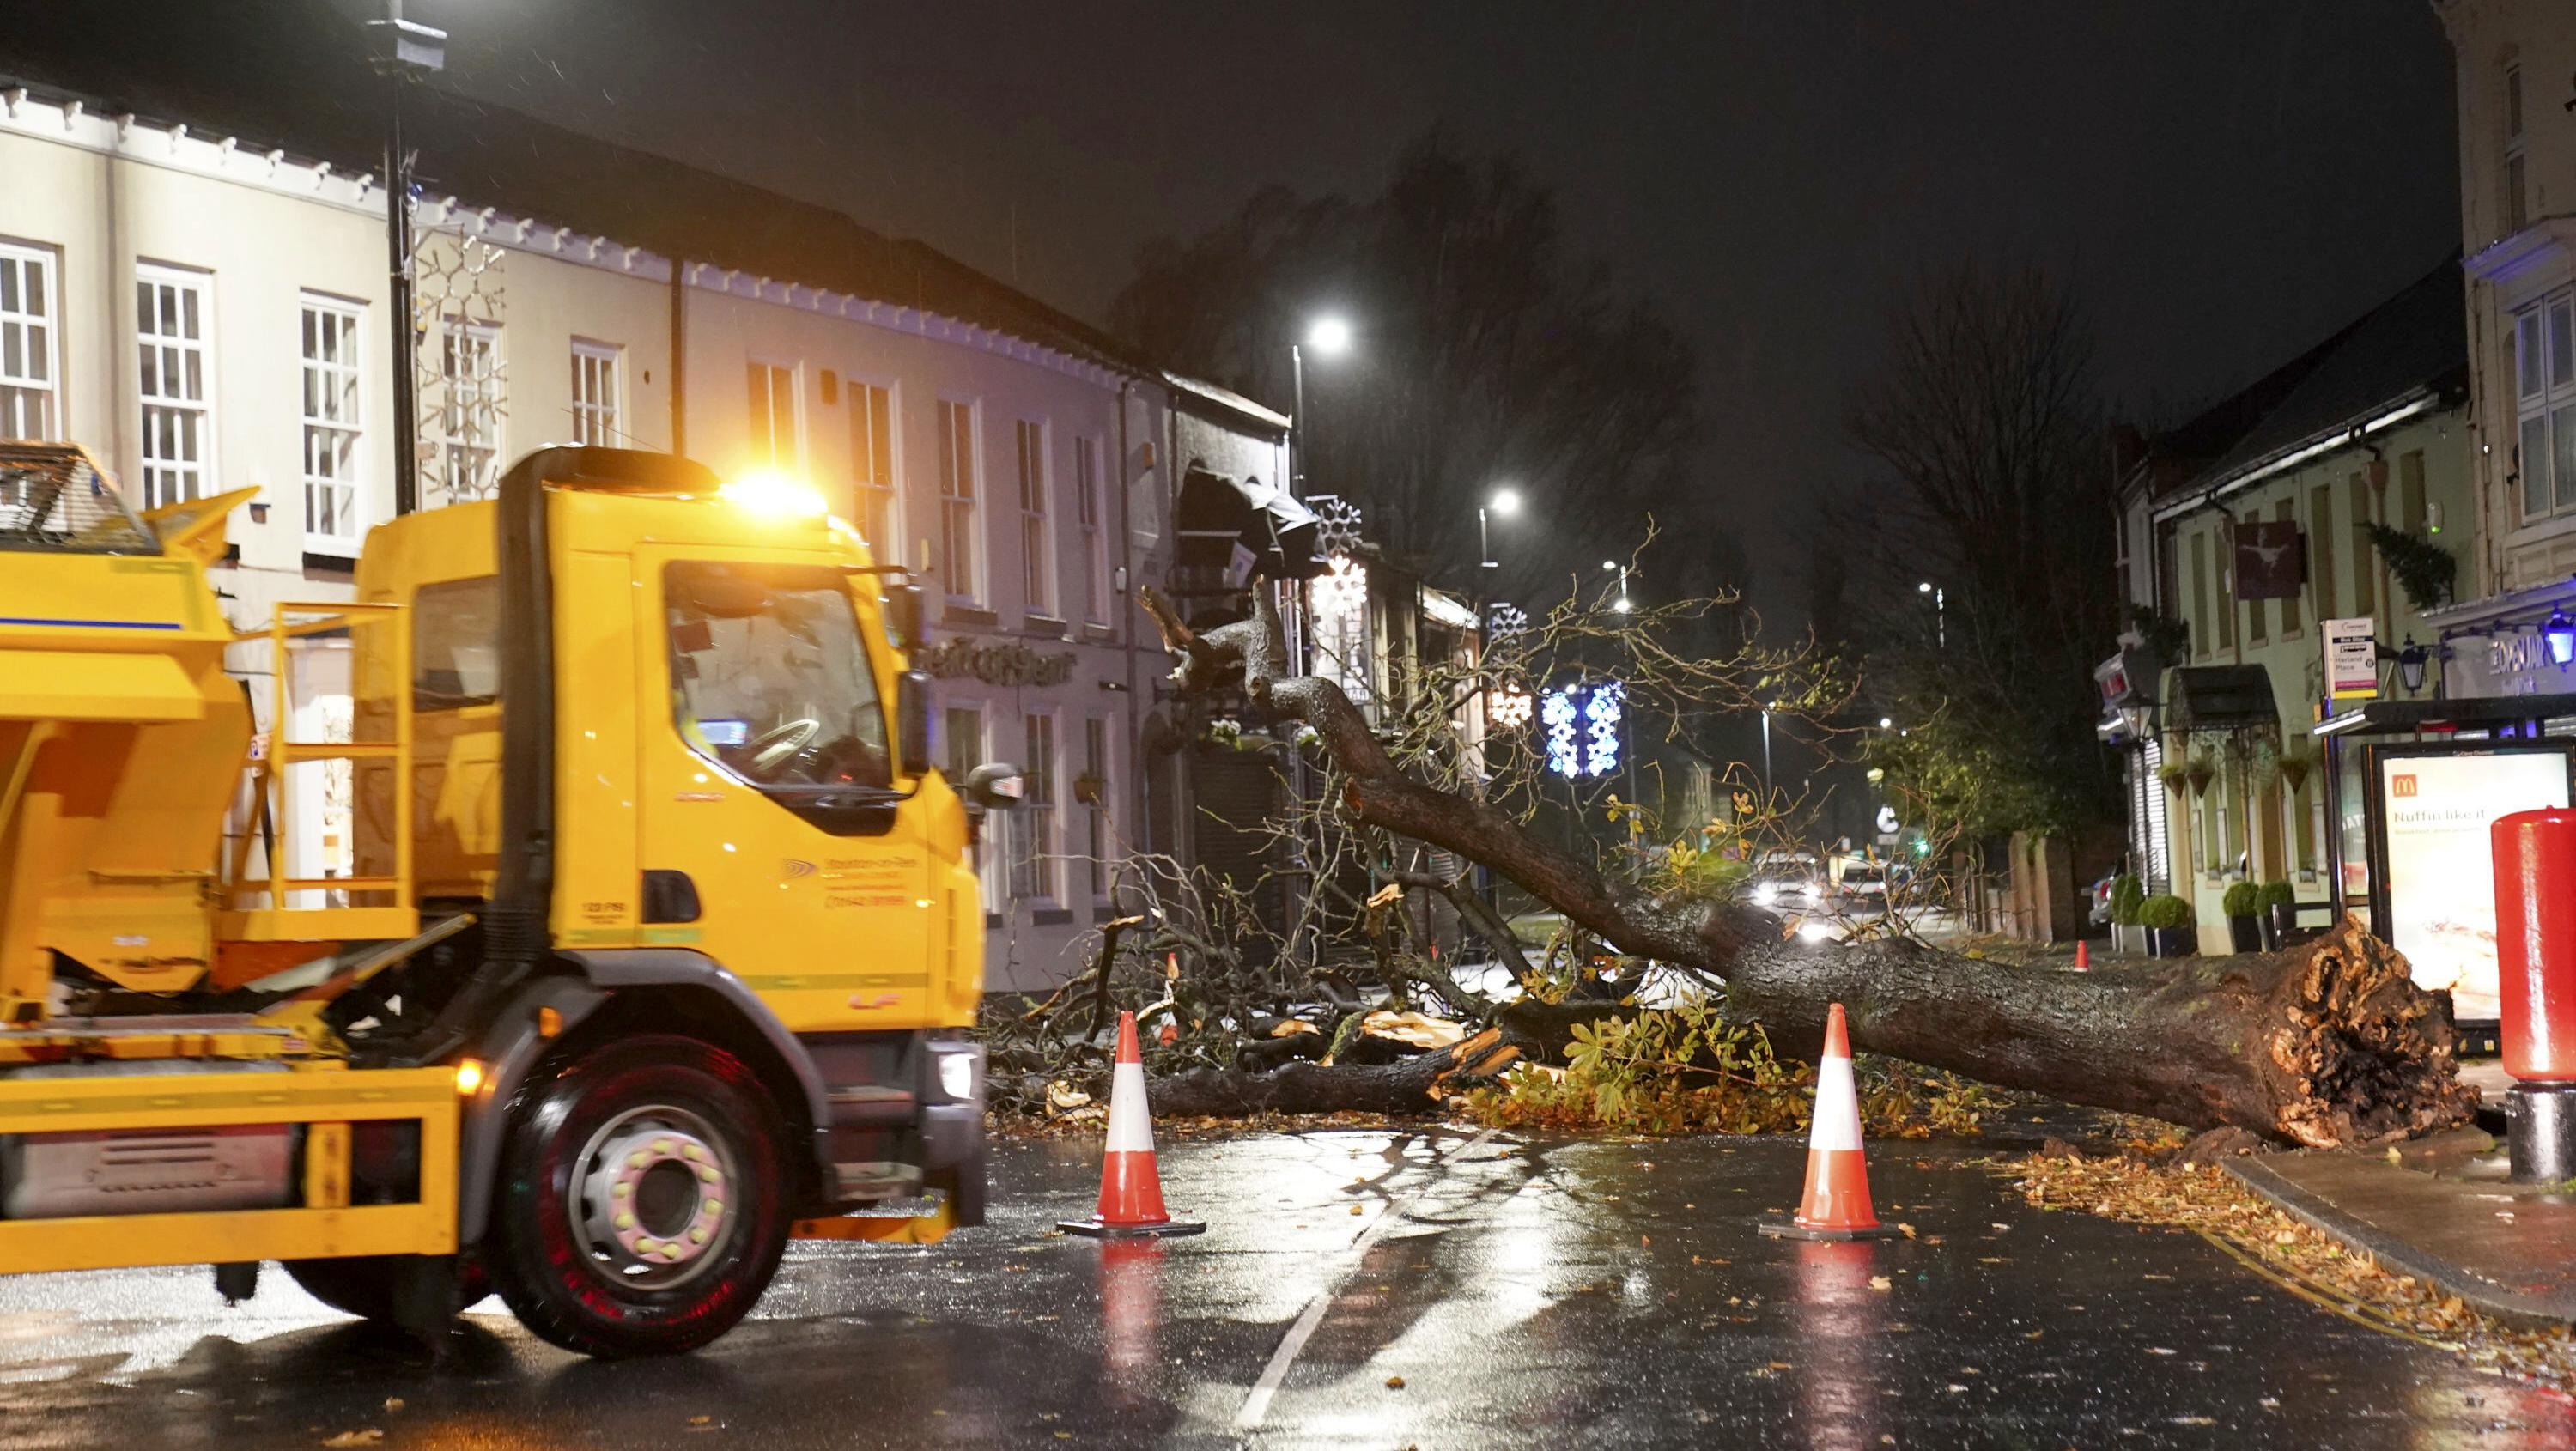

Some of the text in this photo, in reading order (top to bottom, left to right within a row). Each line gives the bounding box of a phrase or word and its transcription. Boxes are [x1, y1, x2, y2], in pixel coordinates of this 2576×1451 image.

[2335, 655, 2363, 664] Harland
[2394, 810, 2441, 823] Nuffin
[2445, 809, 2472, 820] like
